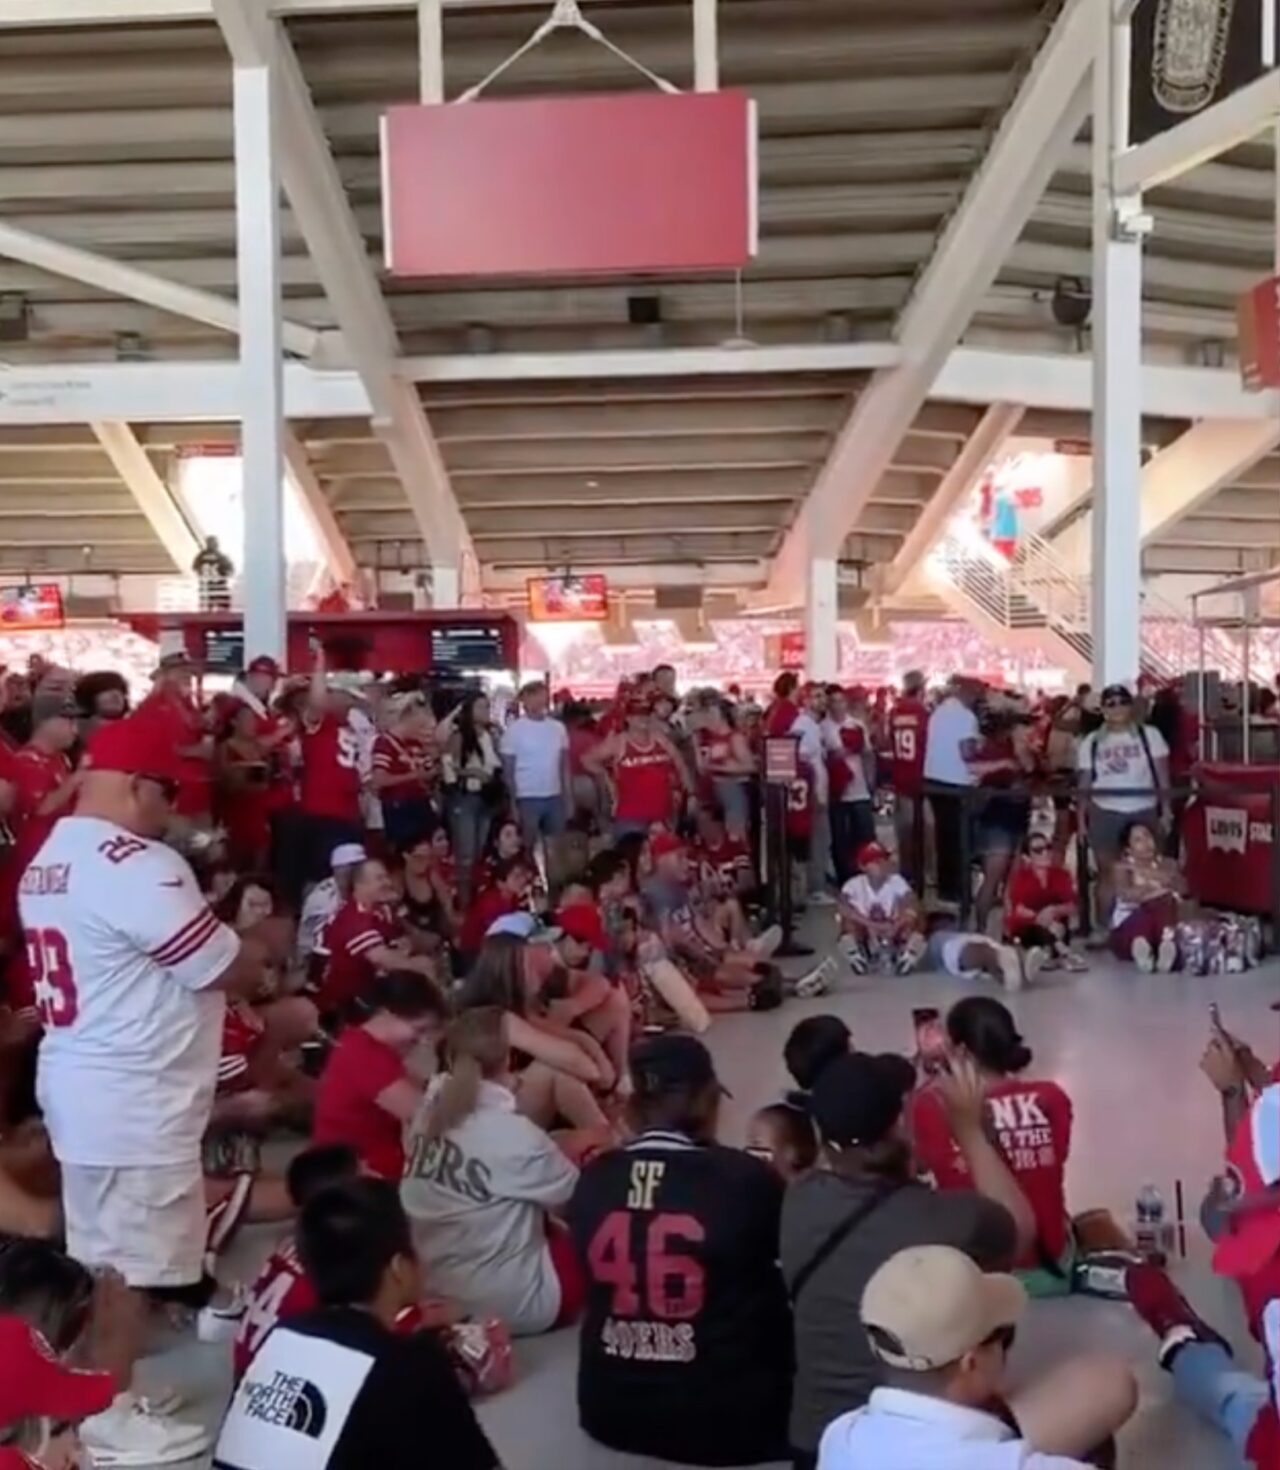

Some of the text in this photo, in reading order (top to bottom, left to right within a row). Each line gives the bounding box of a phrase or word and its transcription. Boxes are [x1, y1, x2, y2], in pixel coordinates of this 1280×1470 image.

[986, 1092, 1049, 1129] NK
[404, 1134, 494, 1203] ERS
[627, 1161, 664, 1210] SF
[588, 1211, 705, 1318] 46
[602, 1318, 697, 1361] 49ERS
[246, 1381, 298, 1410] NORTH
[272, 1370, 305, 1394] THE
[244, 1399, 286, 1426] FACE
